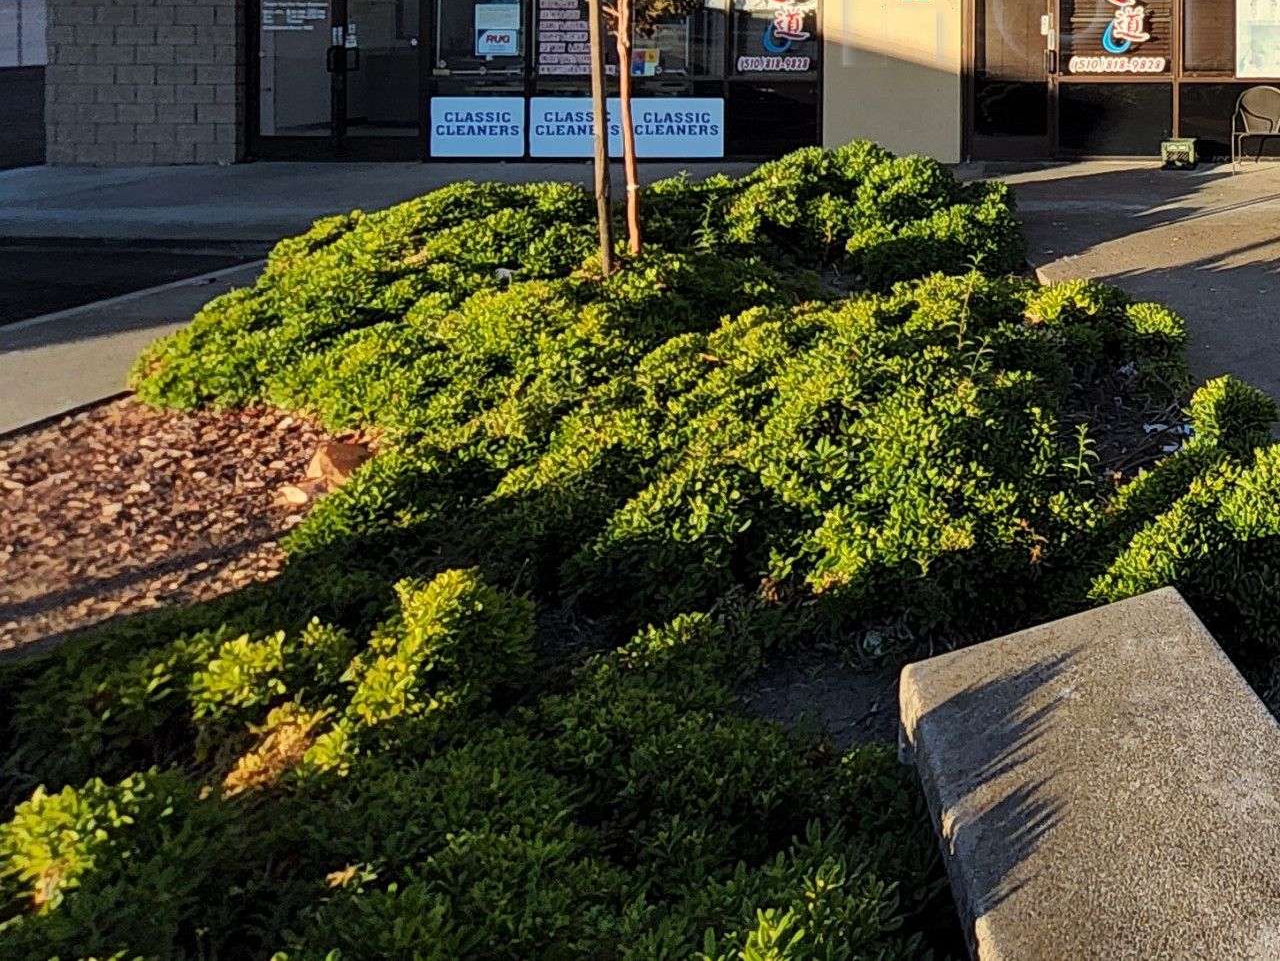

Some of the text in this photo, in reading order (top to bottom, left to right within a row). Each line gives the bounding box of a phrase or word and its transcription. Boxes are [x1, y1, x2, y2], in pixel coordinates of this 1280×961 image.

[444, 112, 511, 123] CLASSIC
[544, 111, 611, 123] CLASSC
[643, 112, 711, 124] CLASSIC
[436, 125, 519, 136] CLEANERS
[535, 125, 620, 136] CLEANES
[634, 125, 719, 136] CLEANERS
